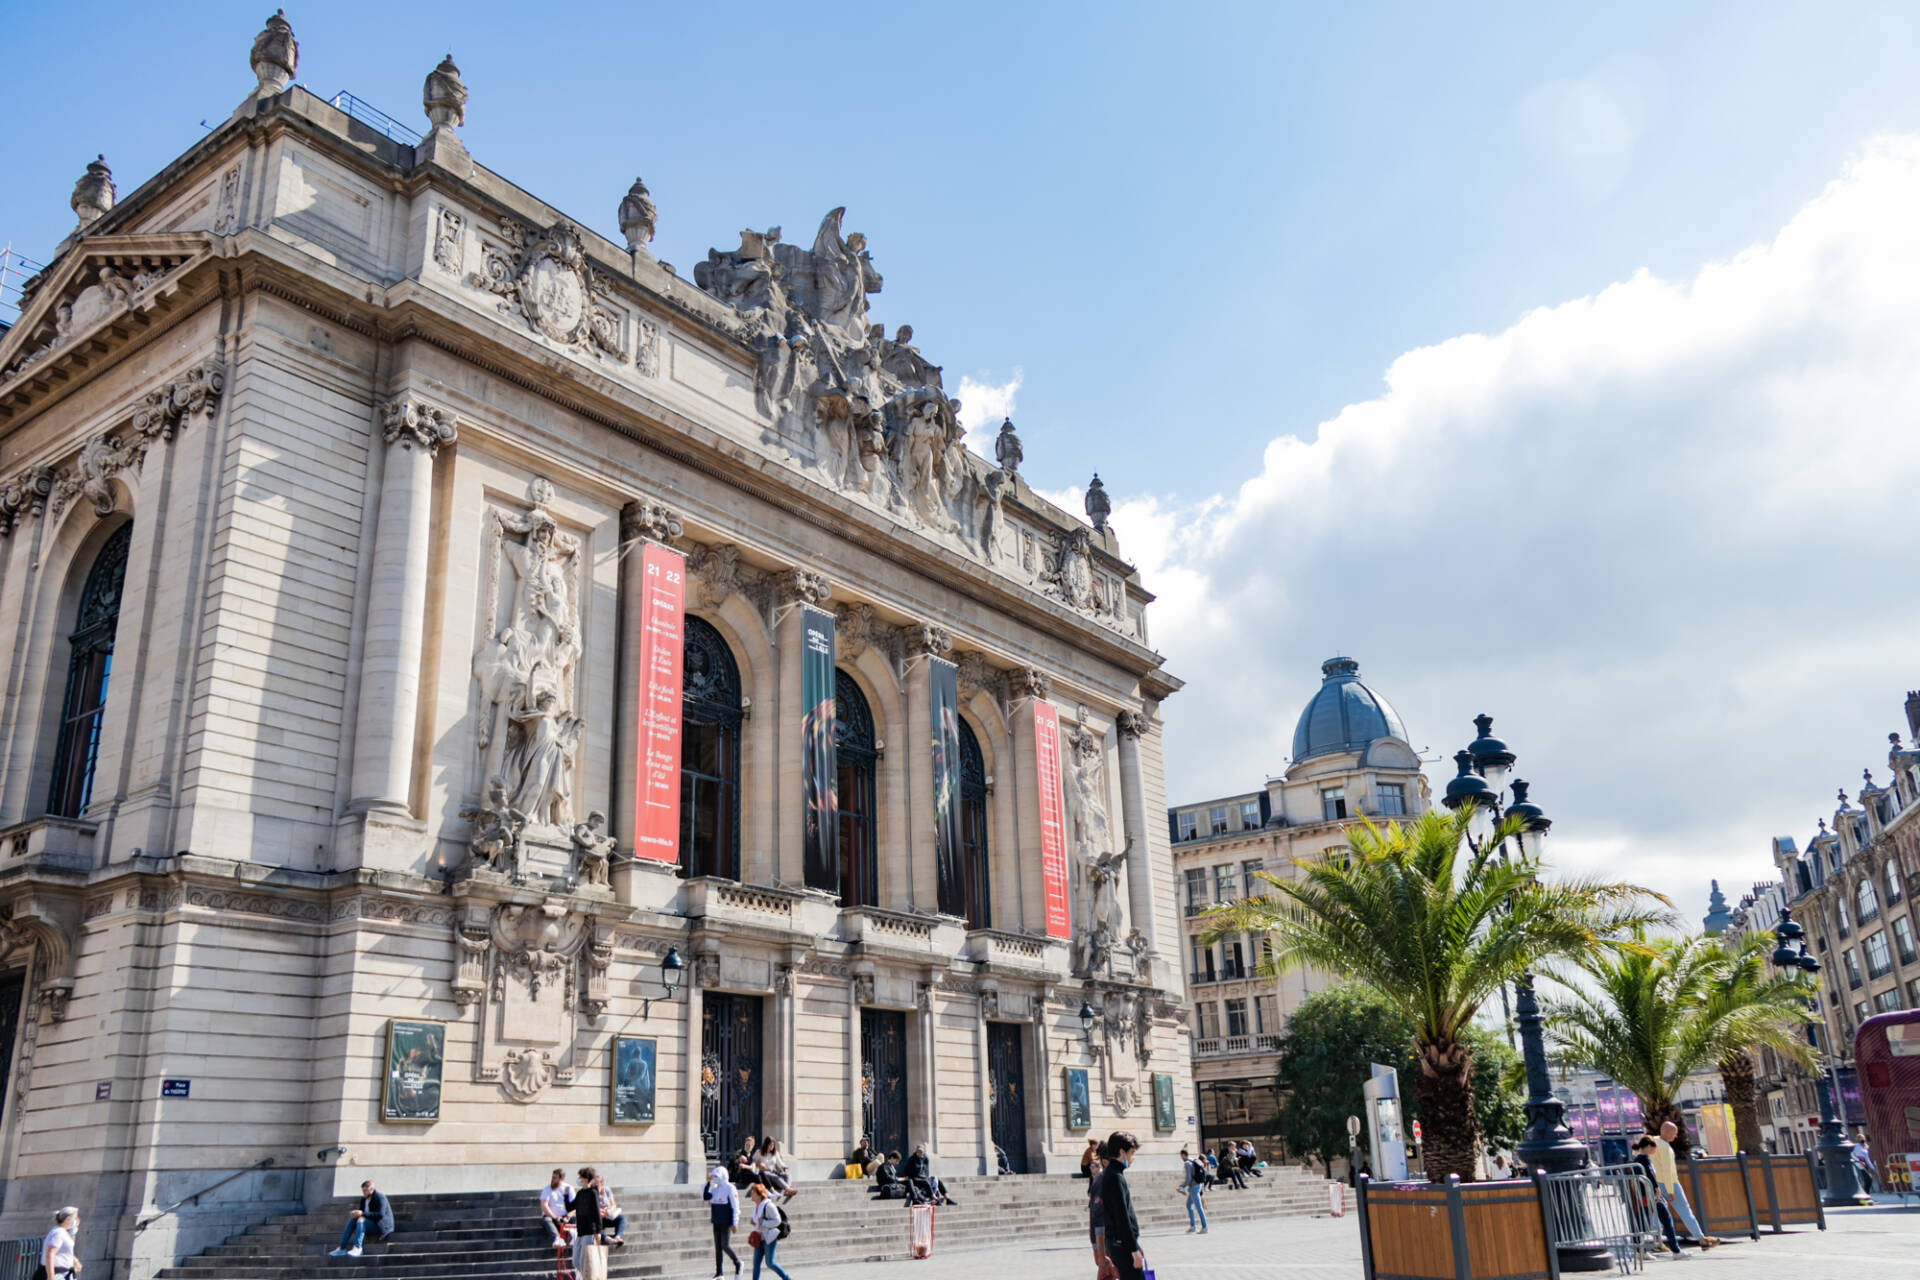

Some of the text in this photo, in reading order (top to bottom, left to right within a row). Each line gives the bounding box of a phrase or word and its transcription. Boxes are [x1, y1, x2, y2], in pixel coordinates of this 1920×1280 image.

[647, 563, 681, 585] 21 22
[808, 628, 825, 640] OPÉRA
[815, 644, 829, 655] LILLE
[1046, 719, 1055, 729] 22
